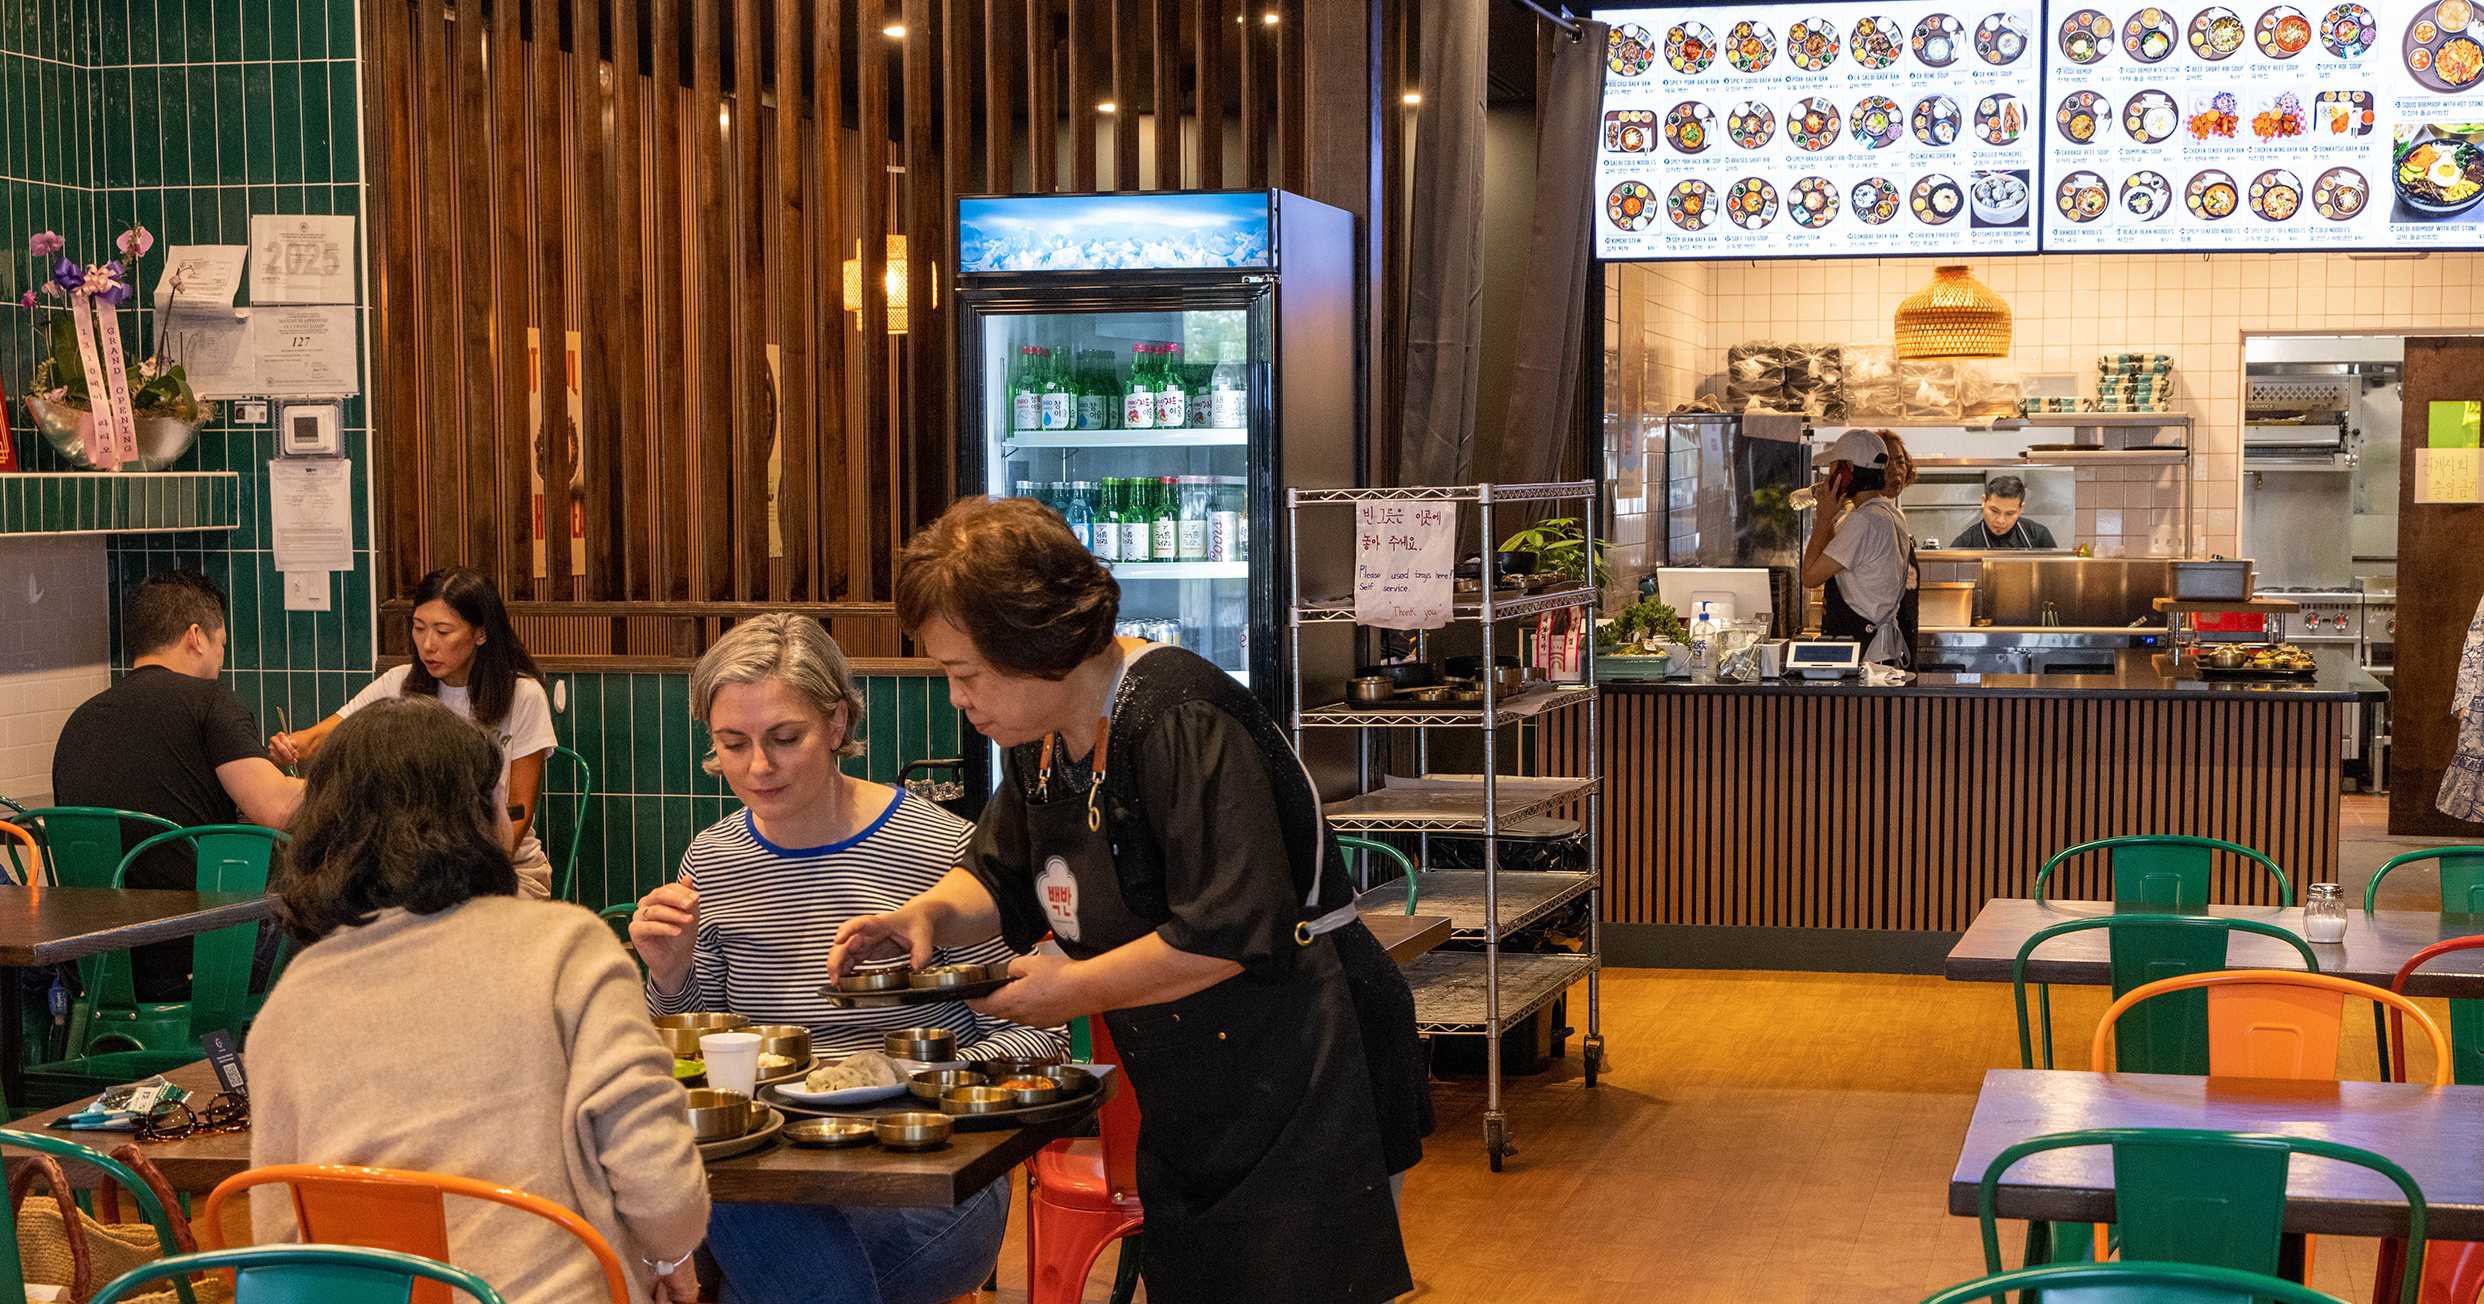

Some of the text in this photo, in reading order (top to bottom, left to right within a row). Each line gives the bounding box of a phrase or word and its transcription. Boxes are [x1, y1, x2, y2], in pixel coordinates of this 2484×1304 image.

[265, 241, 339, 275] 2025
[292, 336, 310, 347] 127
[107, 327, 132, 452] GRAND OPENING
[98, 419, 113, 453] 라디오
[1363, 506, 1442, 527] 빈 그릇은 이곳에
[1209, 520, 1223, 562] Coors
[1362, 532, 1422, 552] 놓아 주세요.
[1359, 564, 1454, 583] Please used trays here!
[1359, 582, 1374, 591] Self
[1047, 885, 1072, 917] 백반
